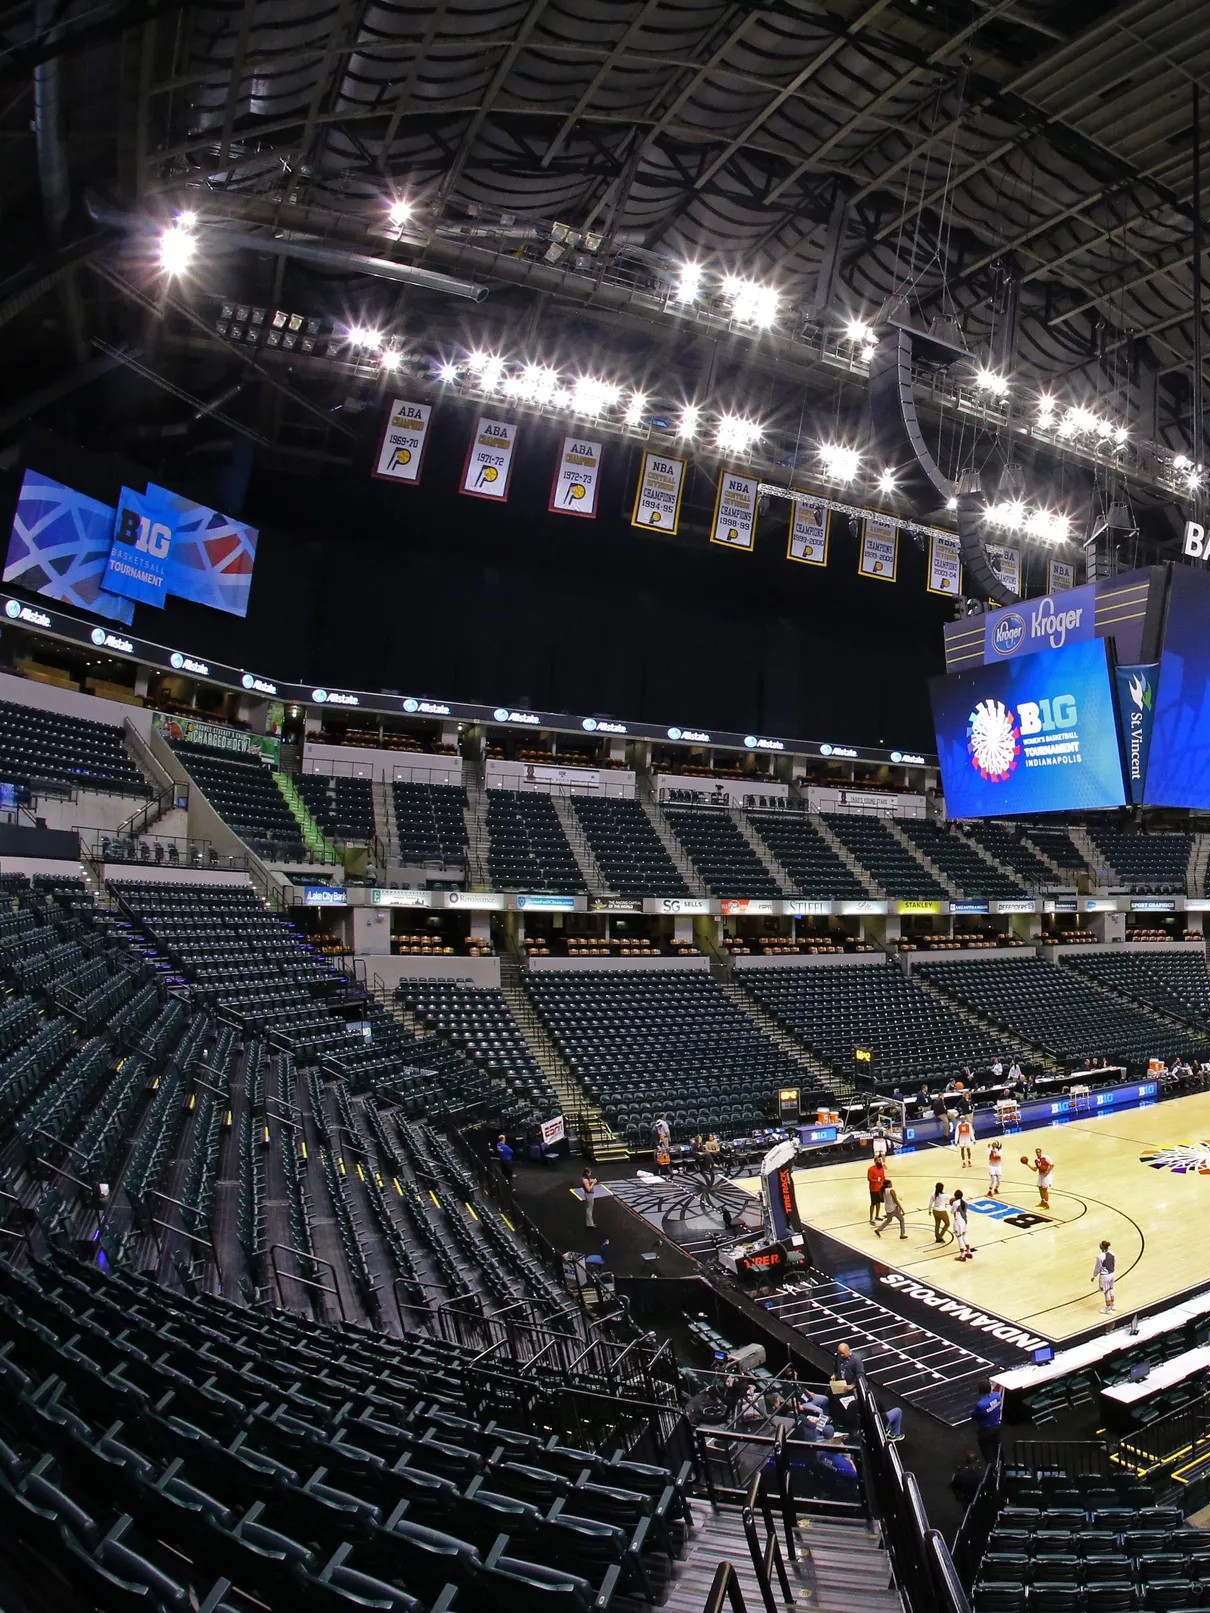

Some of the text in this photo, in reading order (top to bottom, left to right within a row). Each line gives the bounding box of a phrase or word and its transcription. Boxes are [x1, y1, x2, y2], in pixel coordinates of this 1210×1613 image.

[398, 406, 422, 419] ABA
[484, 425, 508, 438] ABA
[570, 443, 593, 457] ABA
[477, 452, 504, 466] 1971-72
[653, 461, 674, 475] NBA
[563, 470, 592, 484] 1972-73
[729, 480, 749, 493] NBA
[643, 488, 676, 504] CHAMPIONS
[721, 506, 752, 522] CHAMPIONS
[111, 547, 165, 575] BASKETBALL
[110, 559, 163, 587] TOURNAMENT
[1054, 564, 1069, 577] NBA
[1031, 598, 1083, 648] Kroger
[996, 621, 1022, 648] Kroger
[193, 730, 227, 748] CHARGED
[232, 738, 248, 753] DEW
[1023, 732, 1078, 745] WOMEN'S BASKETBALL
[1131, 712, 1143, 780] St. Vincent
[1024, 741, 1079, 757] TOURNAMENT
[1026, 754, 1082, 767] INDIANAPOLIS
[309, 891, 347, 903] Lake City Bank
[663, 900, 680, 912] SG
[790, 900, 823, 914] STIFEL
[544, 1120, 562, 1138] ESPN
[780, 1169, 789, 1194] RACK
[784, 1194, 792, 1214] TIRE
[880, 1273, 1049, 1352] INDIANAPOLIS
